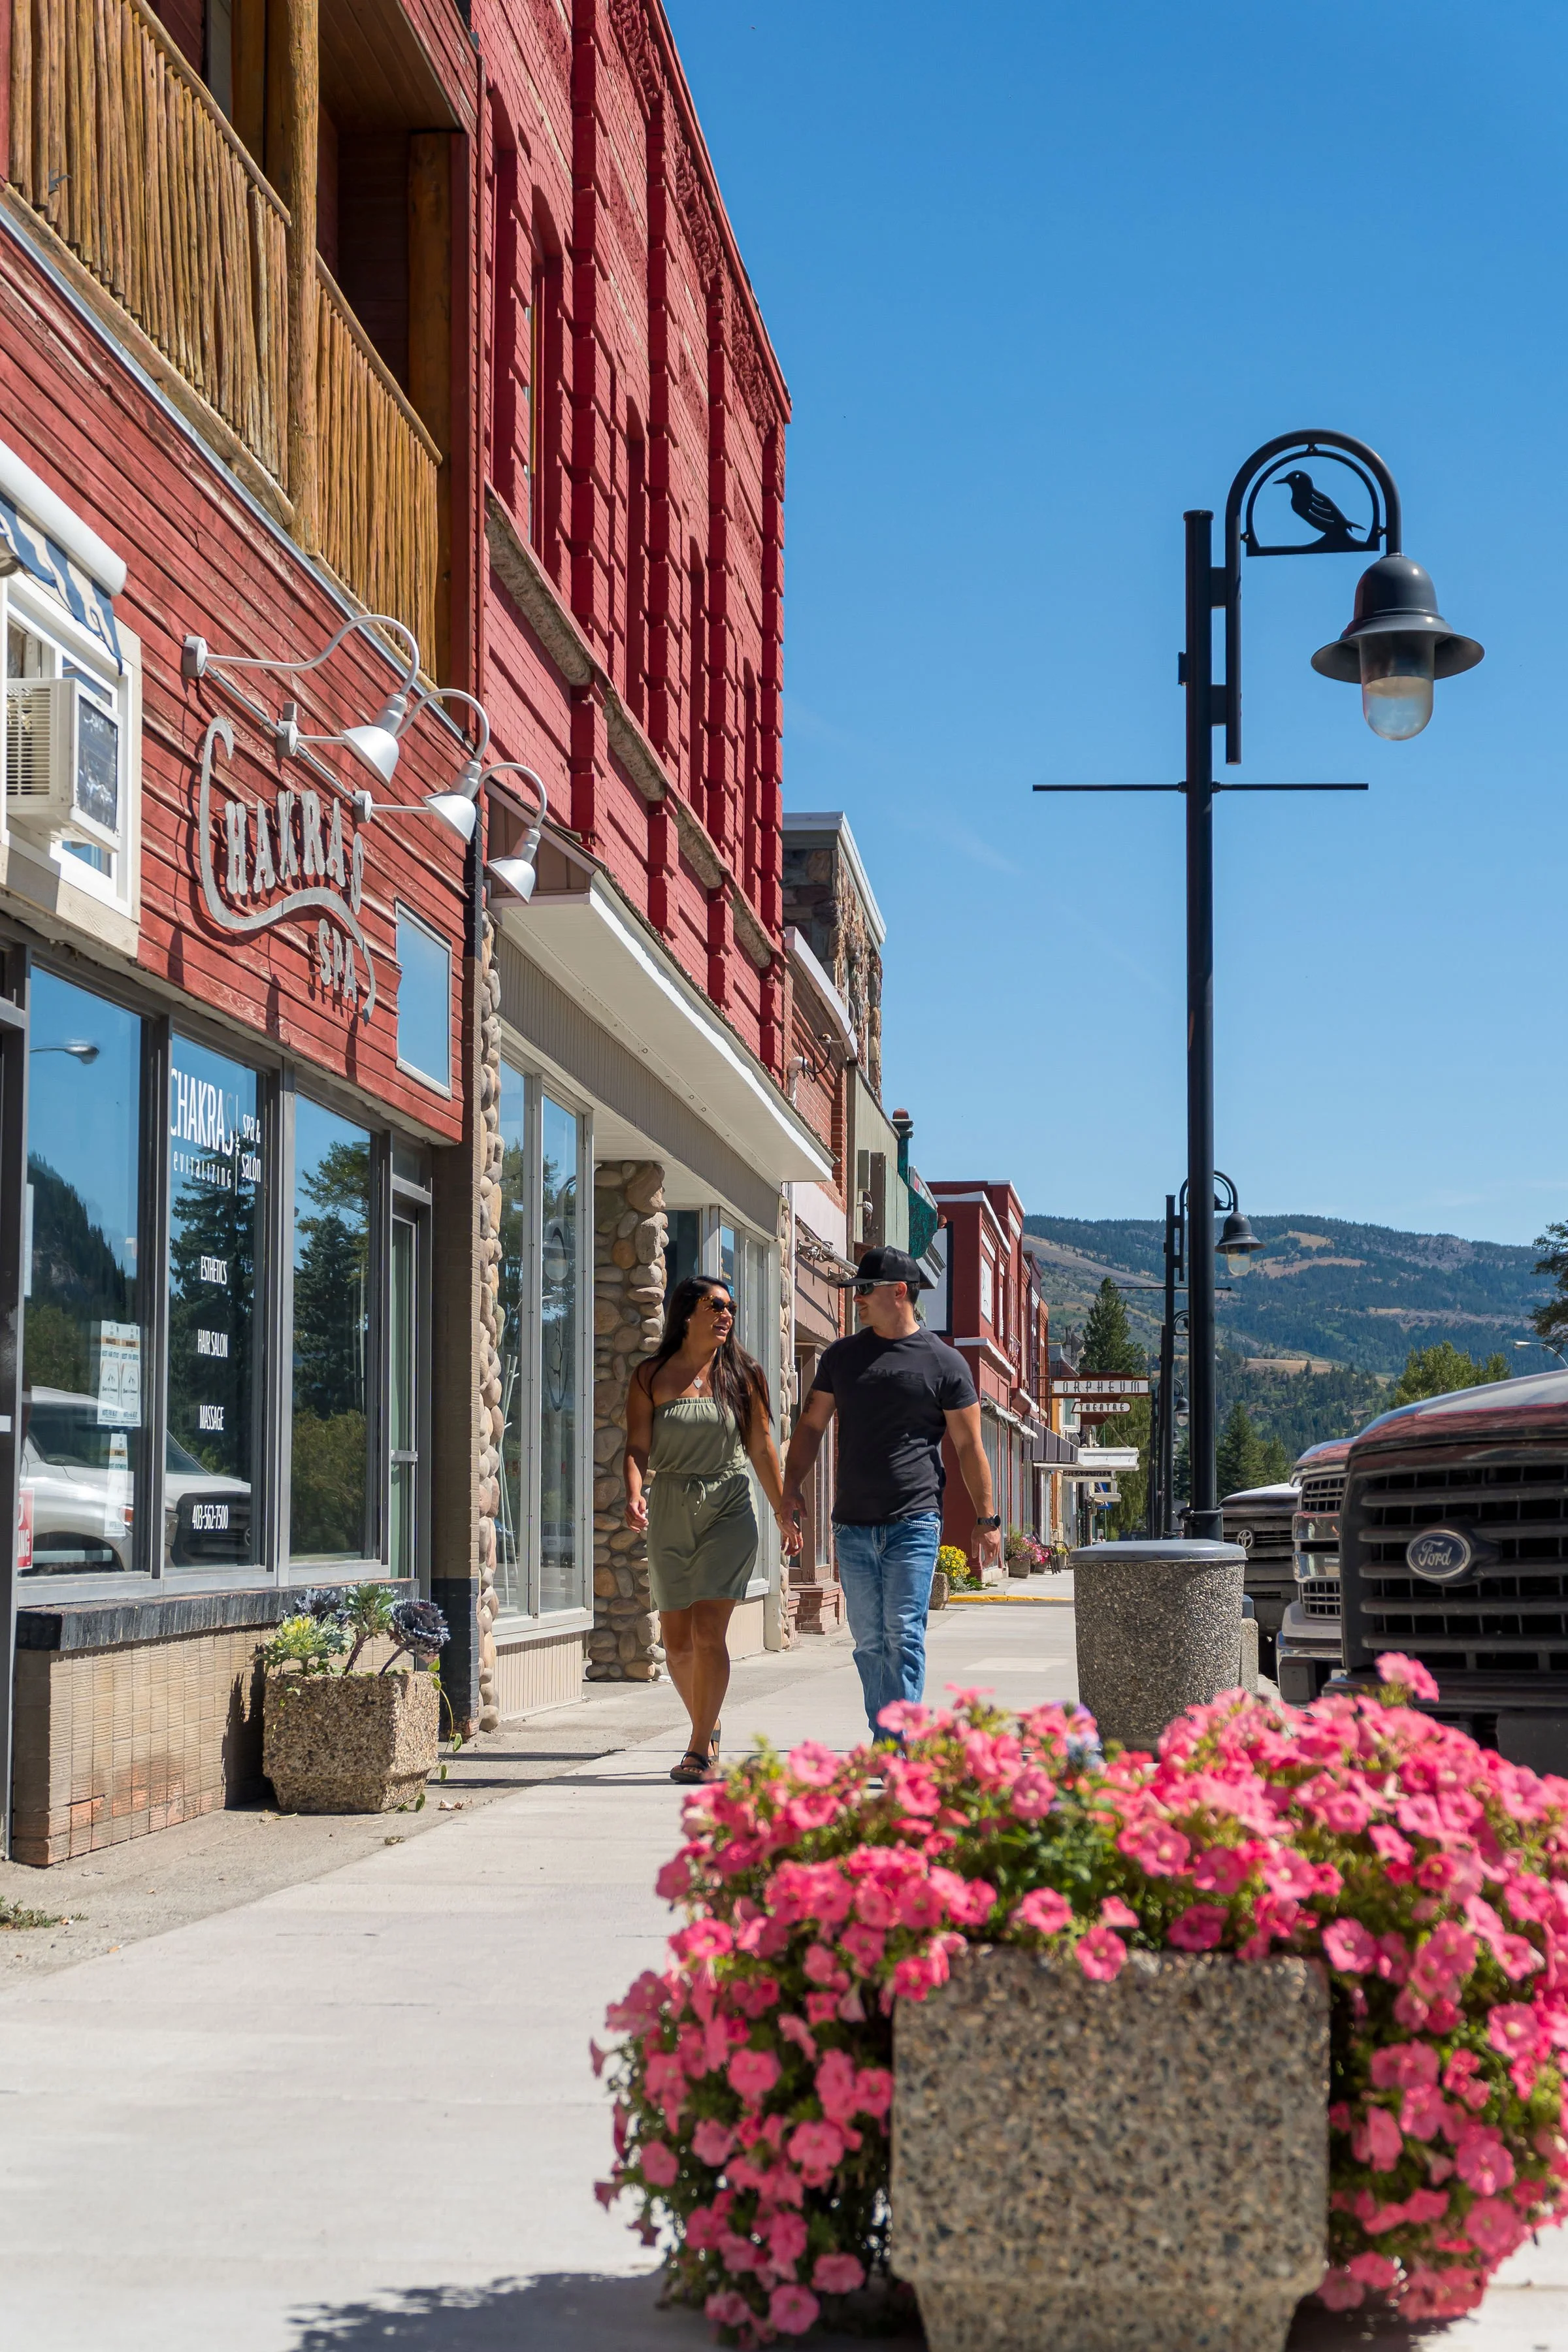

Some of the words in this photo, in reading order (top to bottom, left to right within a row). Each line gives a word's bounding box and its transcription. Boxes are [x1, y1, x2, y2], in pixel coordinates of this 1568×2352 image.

[199, 717, 366, 929] CHAKRAS
[318, 919, 357, 1004] SPA
[255, 1119, 261, 1144] &
[201, 1256, 227, 1285] ESTHETICS
[197, 1328, 210, 1356] HAIR
[211, 1331, 228, 1358] SALON
[1062, 1380, 1140, 1392] ORPHEUM
[199, 1405, 224, 1431] MASSAGE
[192, 1504, 228, 1529] 403-562-7500
[1418, 1539, 1452, 1566] Ford
